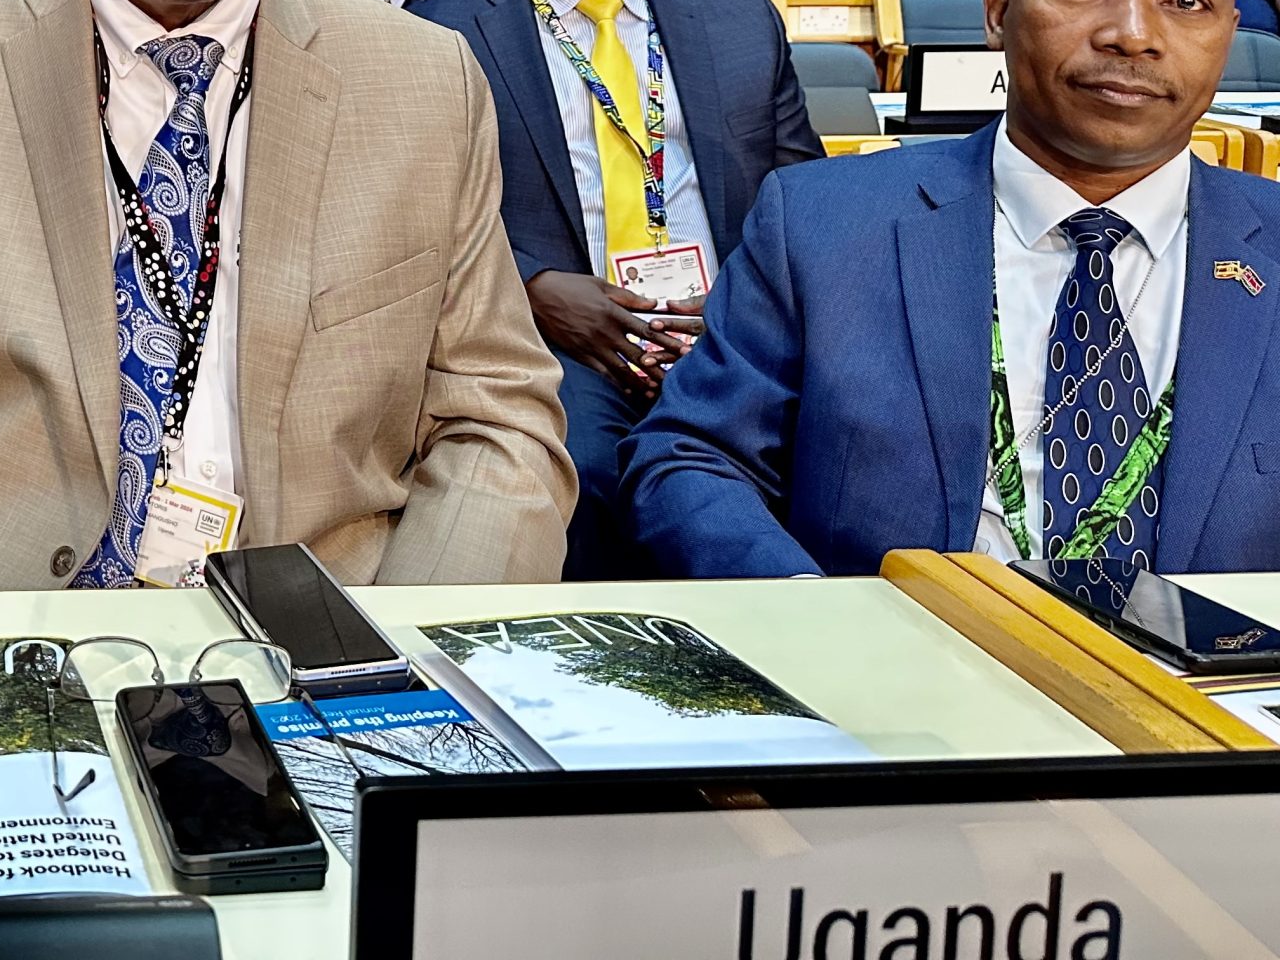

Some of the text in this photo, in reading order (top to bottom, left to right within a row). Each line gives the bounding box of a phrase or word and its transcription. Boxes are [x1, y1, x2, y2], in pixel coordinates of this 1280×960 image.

[442, 614, 718, 655] UNEA
[303, 709, 345, 721] Reprt
[346, 706, 385, 717] Annual
[277, 709, 460, 733] Keeping the prmise
[52, 831, 122, 846] United
[20, 846, 126, 862] Delegates
[20, 864, 131, 879] Handbook
[738, 872, 1124, 960] Uganda
